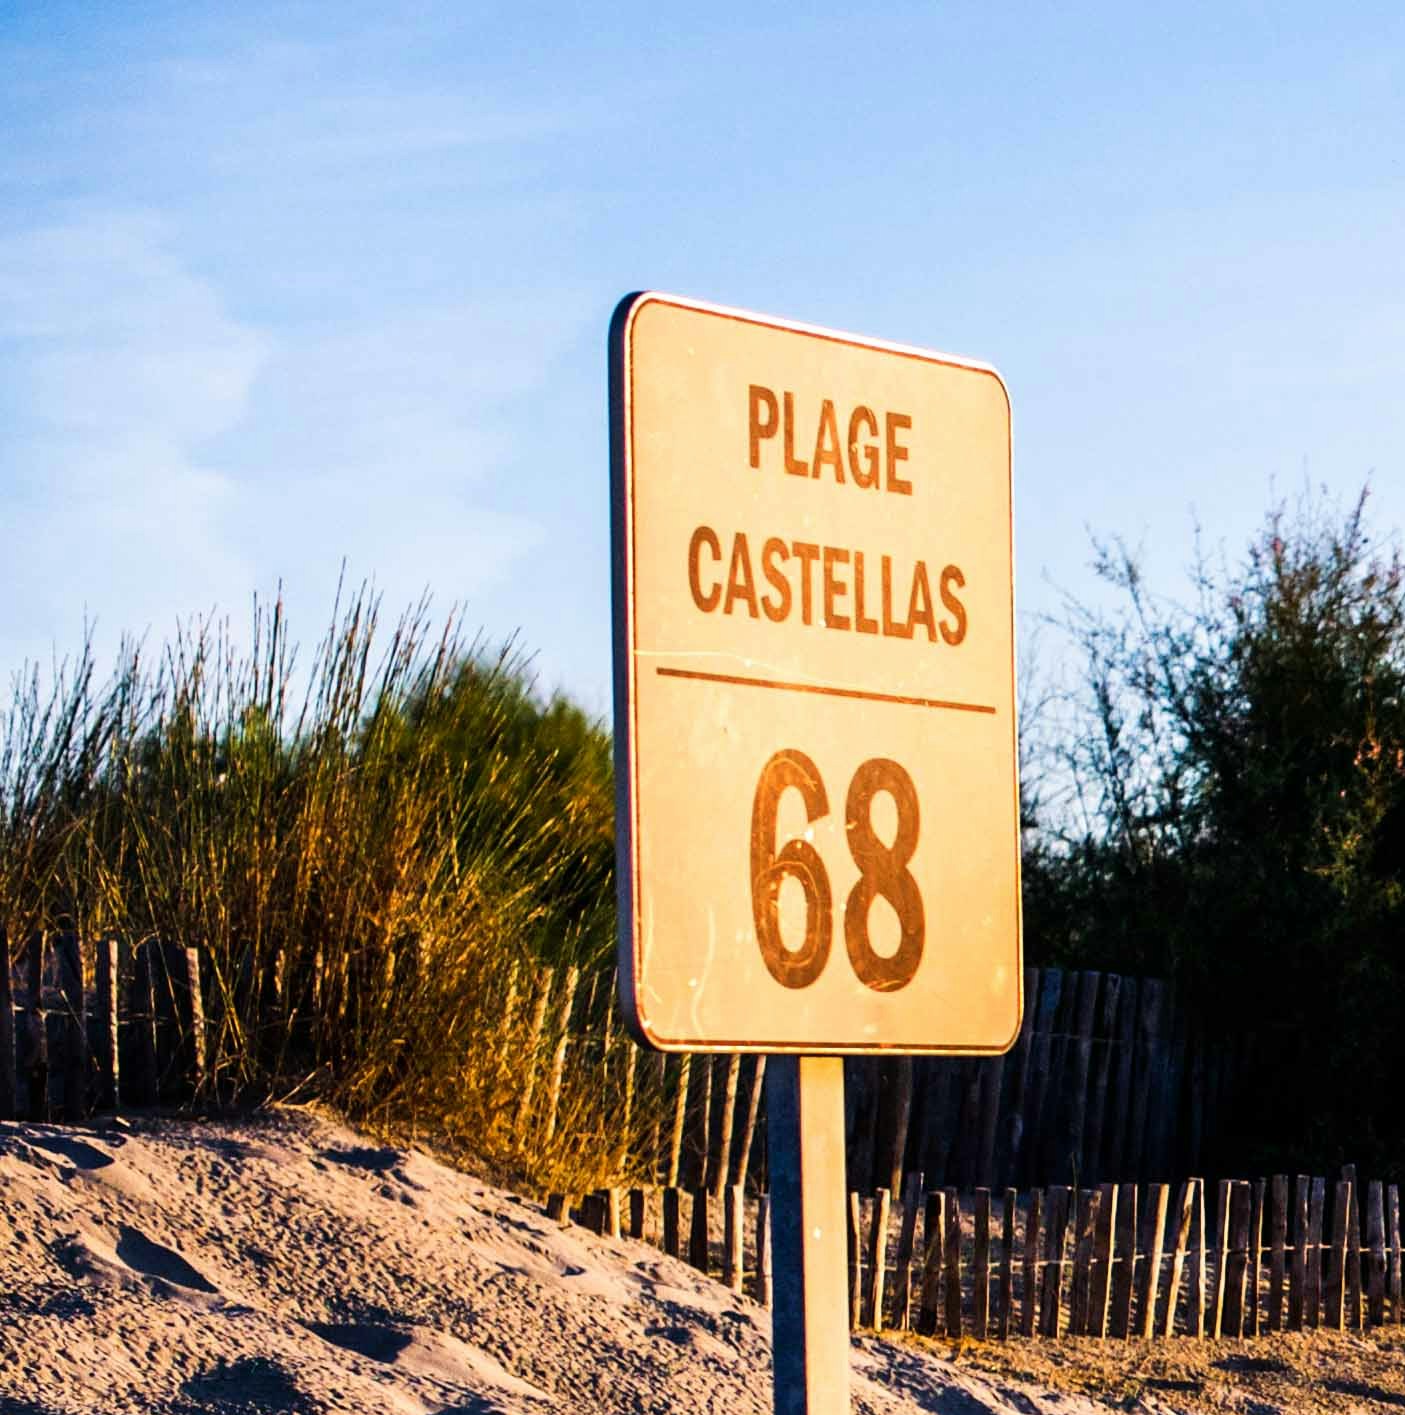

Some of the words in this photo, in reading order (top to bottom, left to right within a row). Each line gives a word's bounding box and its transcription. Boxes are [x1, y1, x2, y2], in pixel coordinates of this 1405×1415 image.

[748, 384, 913, 496] PLAGE
[689, 525, 968, 648] CASTELLAS
[749, 748, 926, 993] 68
